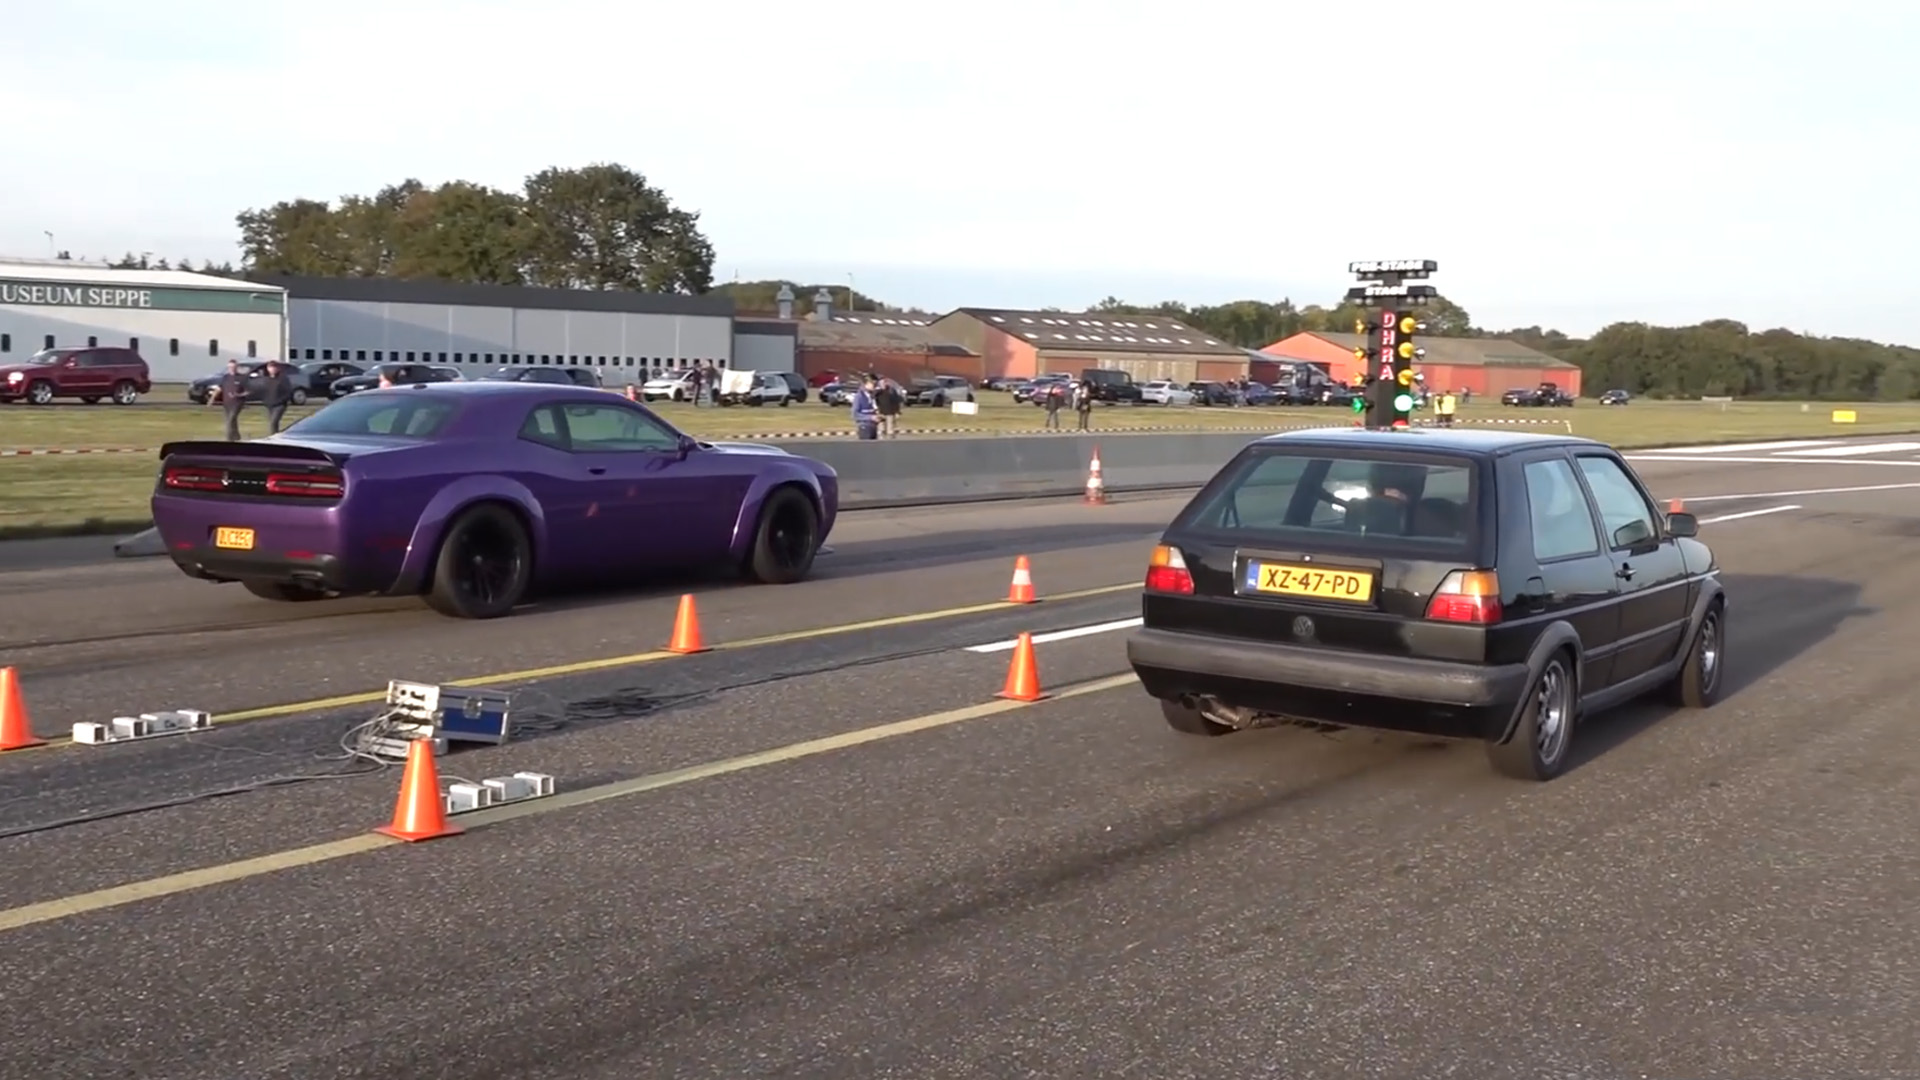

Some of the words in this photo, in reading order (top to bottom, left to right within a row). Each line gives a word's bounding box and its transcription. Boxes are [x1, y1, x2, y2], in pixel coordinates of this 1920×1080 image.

[0, 285, 82, 304] USEUM
[88, 288, 152, 307] SEPPE
[1364, 286, 1408, 296] STAGE
[1379, 312, 1396, 380] DHRA
[1265, 568, 1360, 595] XZ-47-PD
